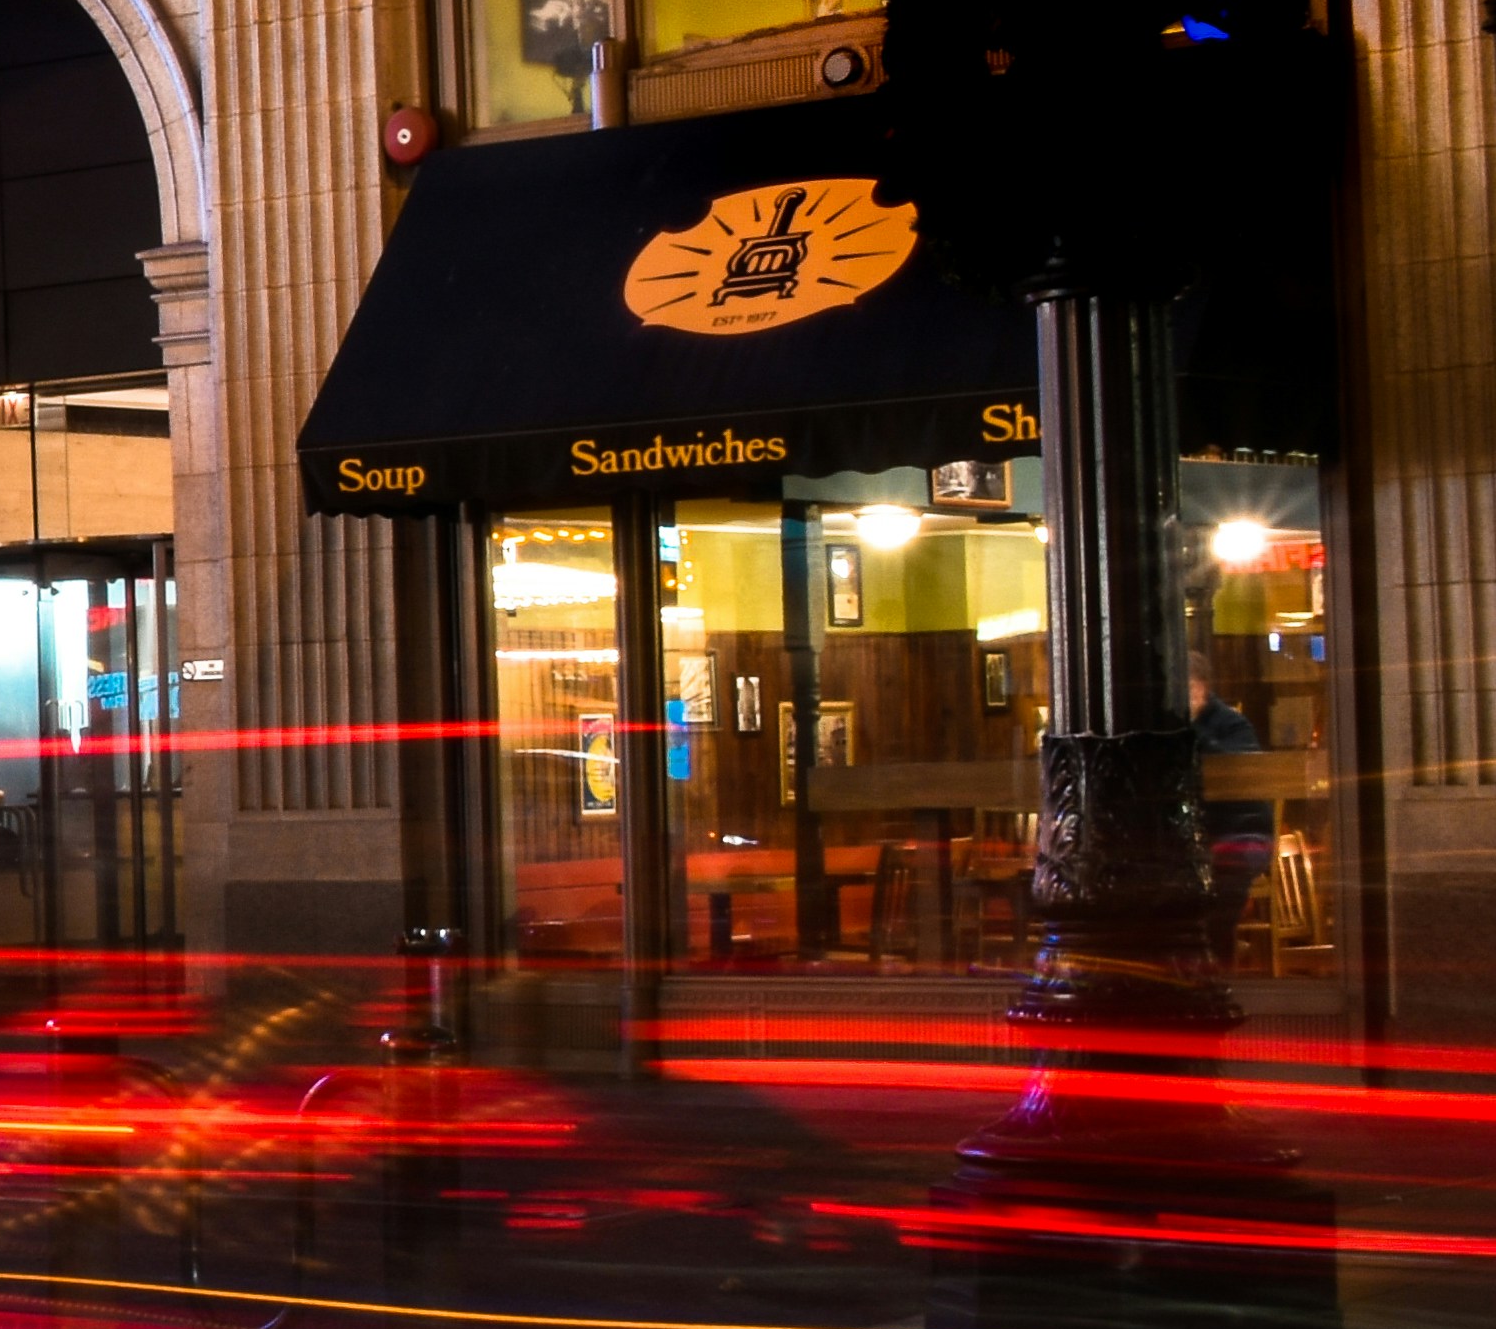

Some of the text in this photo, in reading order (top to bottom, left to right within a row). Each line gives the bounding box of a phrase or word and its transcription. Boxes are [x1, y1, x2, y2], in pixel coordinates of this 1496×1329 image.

[338, 403, 1043, 494] Soup Sandwiches Sh
